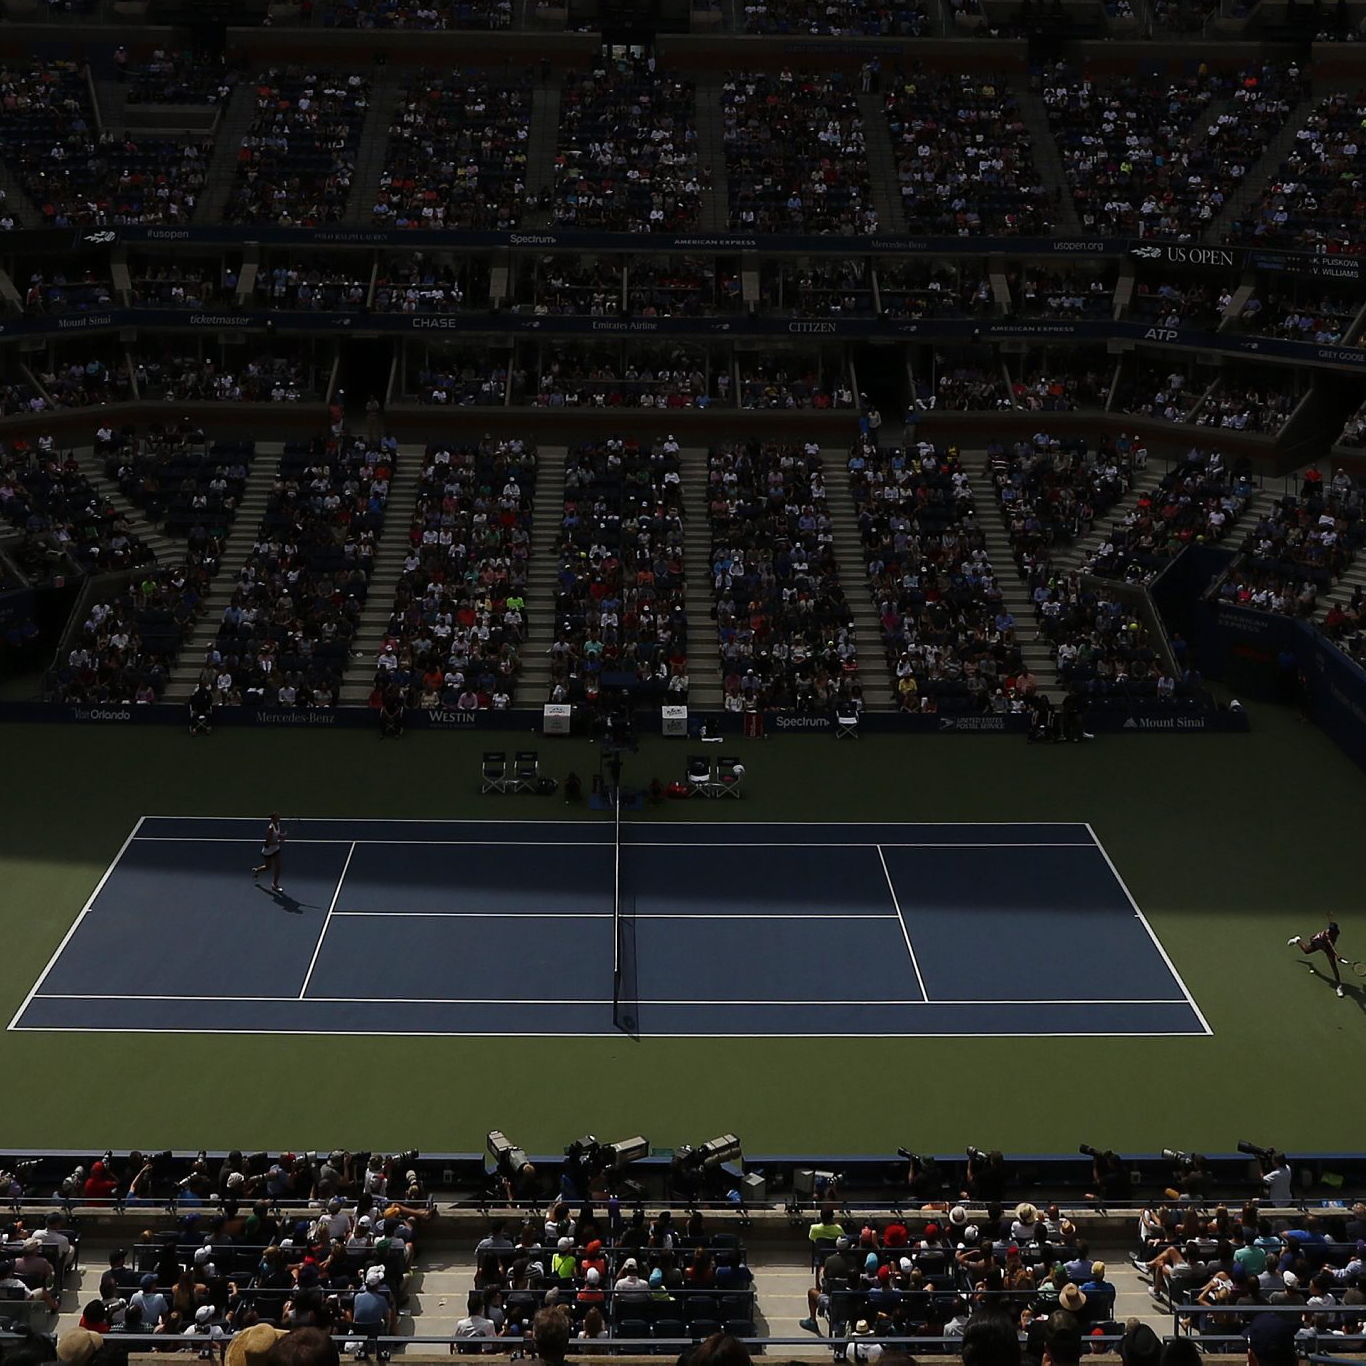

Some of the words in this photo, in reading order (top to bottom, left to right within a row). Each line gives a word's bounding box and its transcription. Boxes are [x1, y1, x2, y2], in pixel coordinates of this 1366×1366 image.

[509, 234, 553, 245] Spectrum
[1052, 242, 1104, 253] usopen.org
[1167, 246, 1187, 262] US
[1189, 248, 1234, 266] OPEN
[1322, 257, 1359, 268] PLISKOVA
[1322, 268, 1359, 278] WILLIAMS
[58, 316, 87, 328] Mount
[88, 314, 112, 326] Sinai
[189, 315, 251, 325] ticketmaster
[412, 318, 457, 329] CHASE
[592, 320, 629, 331] Emirates
[630, 320, 658, 331] Airline
[789, 322, 837, 333] CITIZEN
[990, 324, 1035, 333] AMERICAN
[1037, 325, 1075, 334] EXPRESS
[1144, 328, 1178, 341] ATP
[1318, 350, 1338, 359] GREY
[1339, 351, 1366, 362] GOOSE
[90, 708, 131, 721] Orlando
[256, 710, 335, 724] Mercedes-Benz
[428, 710, 475, 723] WESTIN
[775, 715, 827, 729] Spectrum
[1139, 716, 1174, 728] Mount
[1176, 715, 1205, 728] Sinai
